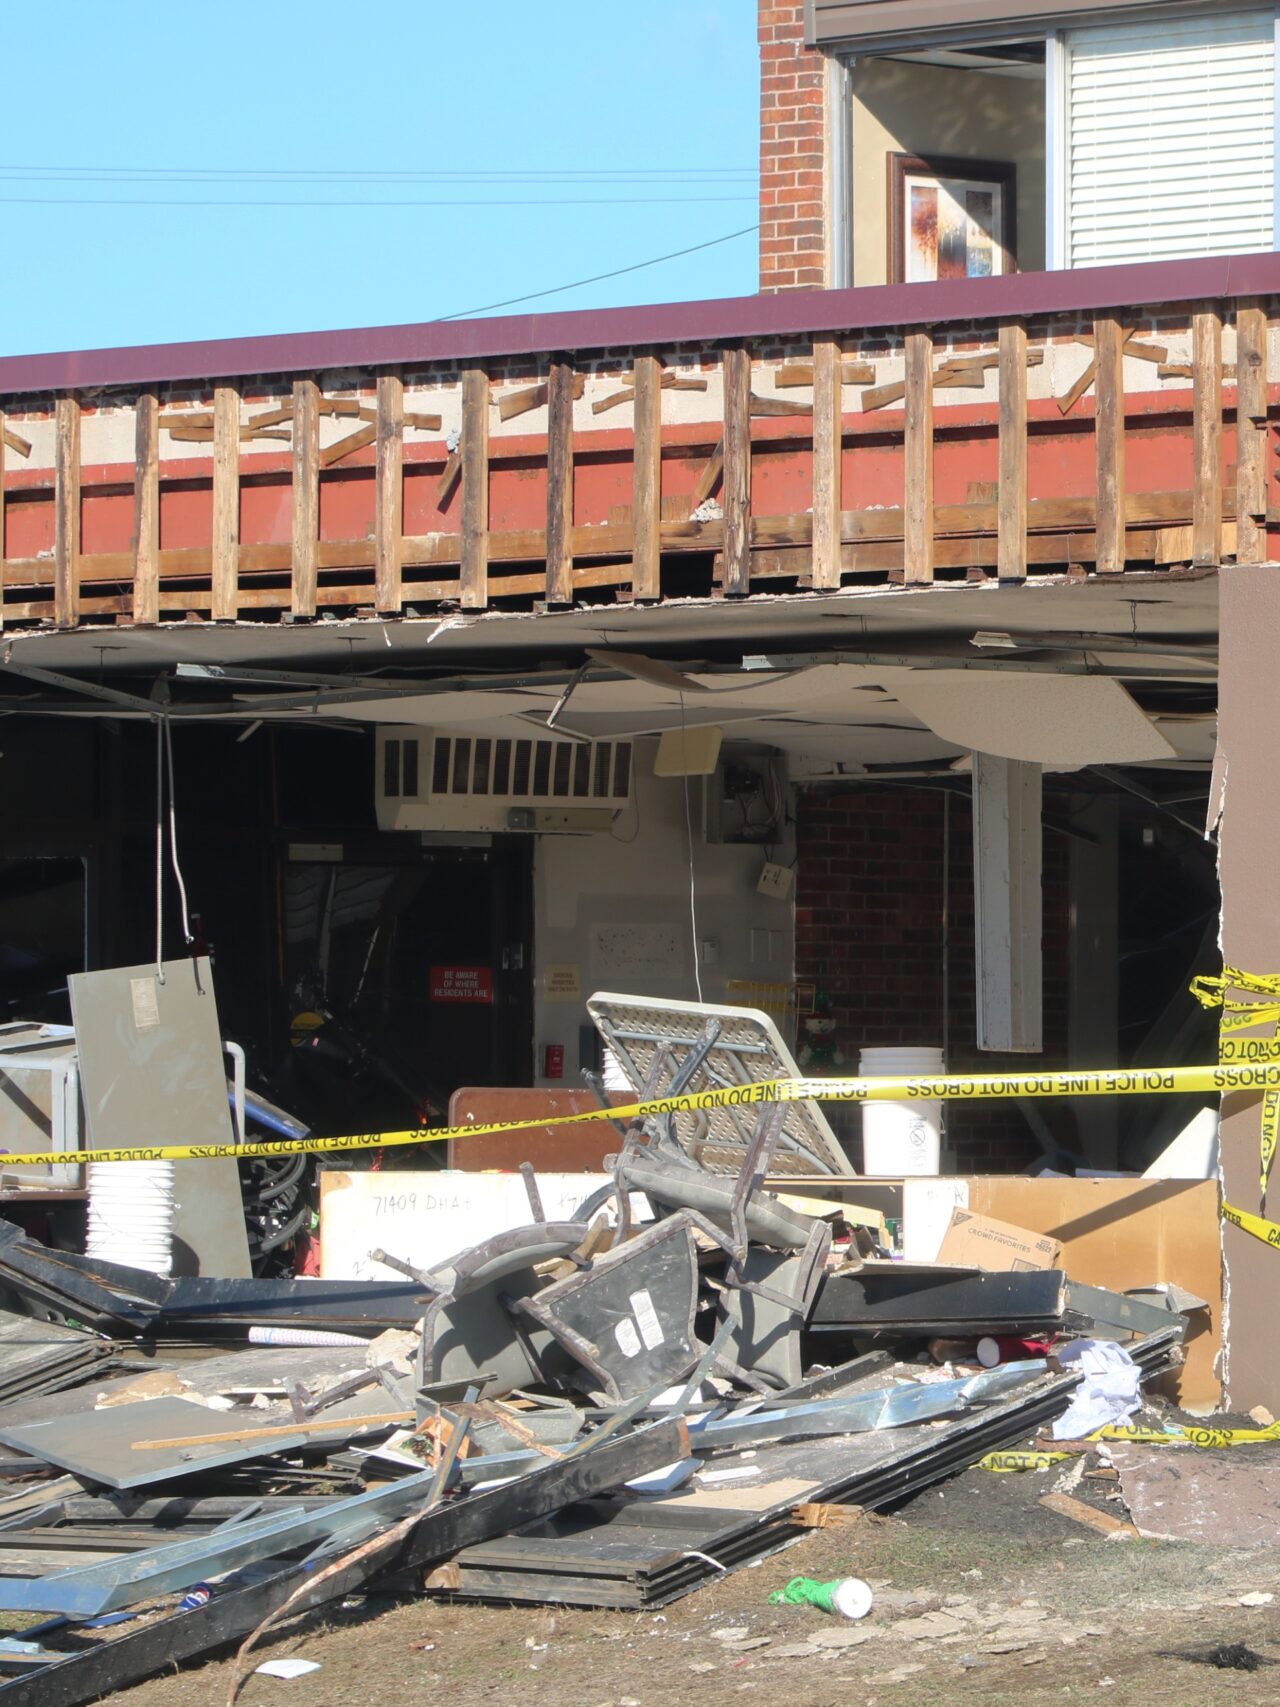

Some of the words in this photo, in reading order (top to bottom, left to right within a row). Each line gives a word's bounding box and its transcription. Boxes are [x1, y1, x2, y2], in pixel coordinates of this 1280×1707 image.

[455, 971, 479, 979] AWARE
[443, 980, 454, 988] OF
[455, 980, 479, 988] WHERE
[434, 989, 472, 997] RESIDENTS
[474, 990, 488, 998] ARE
[1024, 1076, 1054, 1093] DO
[1058, 1074, 1100, 1093] LINE
[1105, 1071, 1175, 1091] POLICE
[1213, 1066, 1280, 1087] CROSS
[907, 1080, 975, 1097] CROSS
[980, 1078, 1019, 1095] NOT
[373, 1194, 418, 1217] 71409
[968, 1227, 994, 1241] CROWD
[993, 1235, 1031, 1254] FAVORITES
[990, 1455, 1030, 1469] NOT
